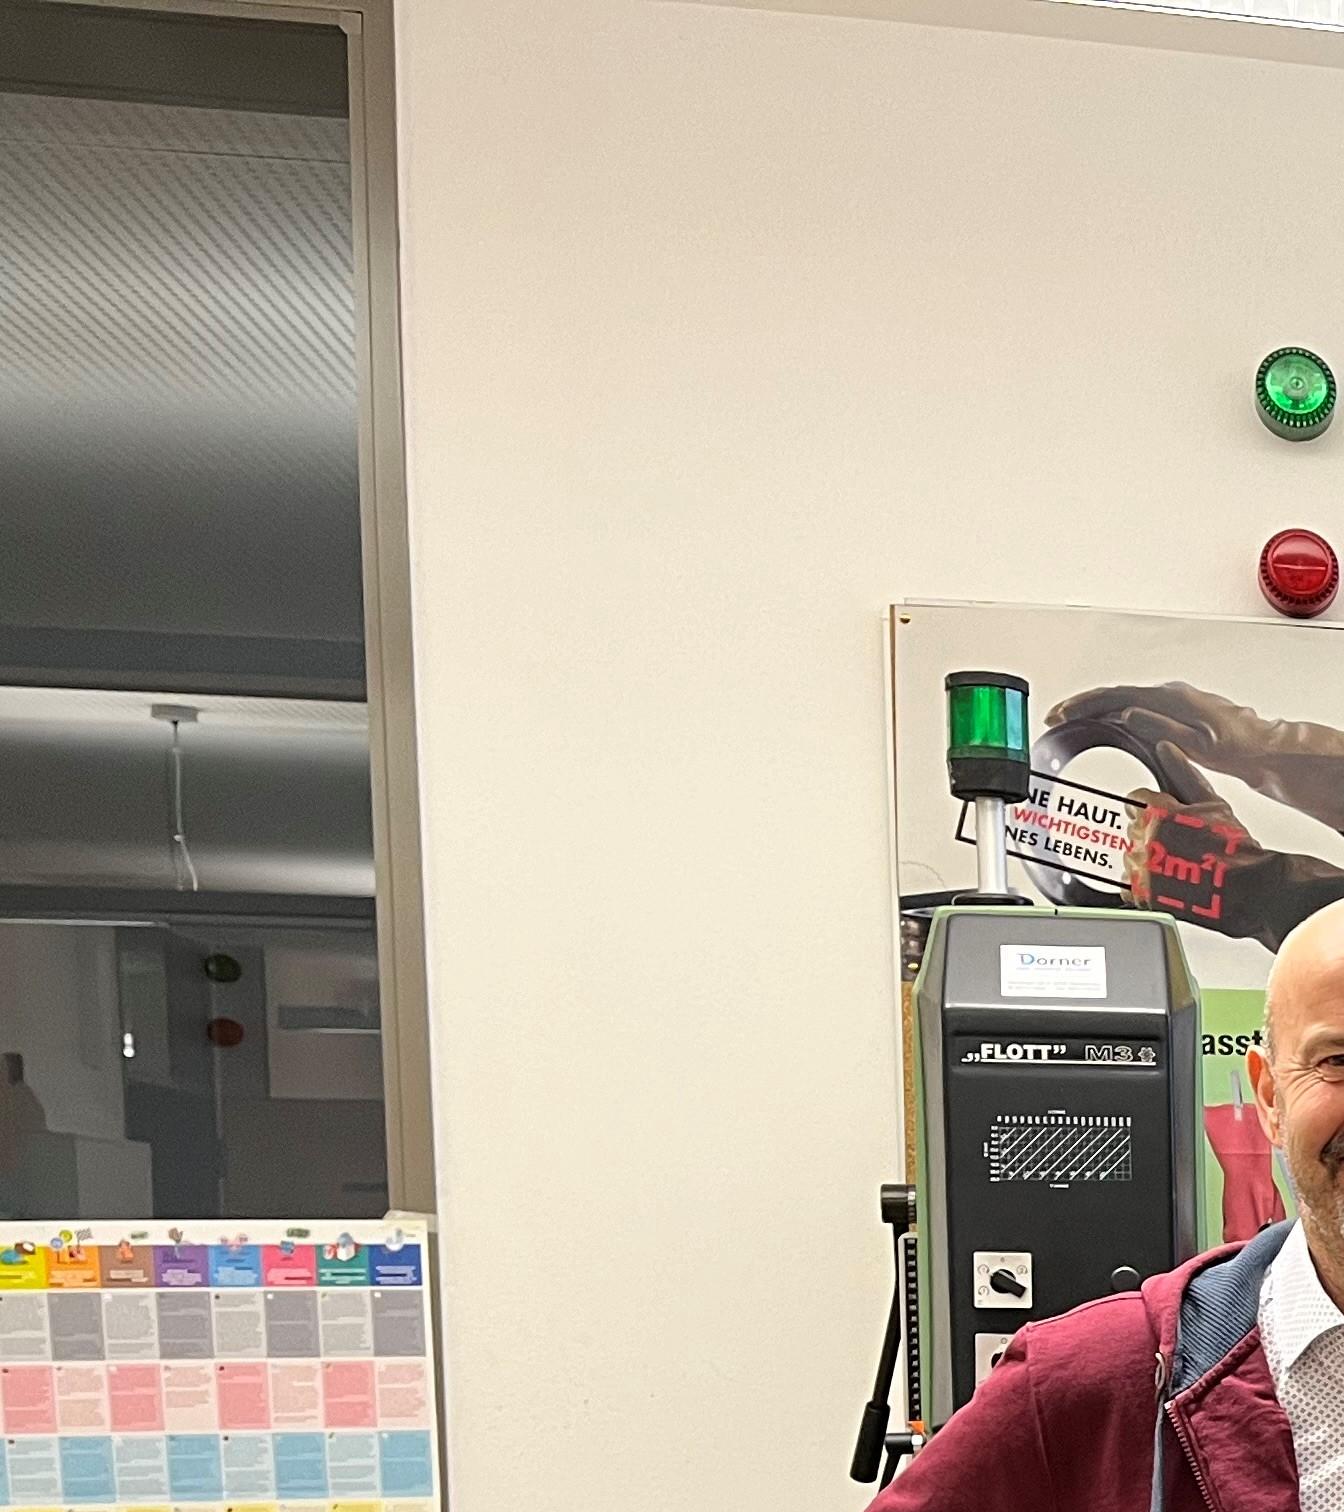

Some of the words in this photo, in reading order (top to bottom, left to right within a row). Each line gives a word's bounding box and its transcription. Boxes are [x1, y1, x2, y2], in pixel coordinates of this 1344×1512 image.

[1014, 806, 1134, 852] WICHTIGSTEN
[1057, 796, 1122, 830] HAUT.
[1044, 836, 1113, 869] LEBENS.
[1201, 1029, 1264, 1057] asst
